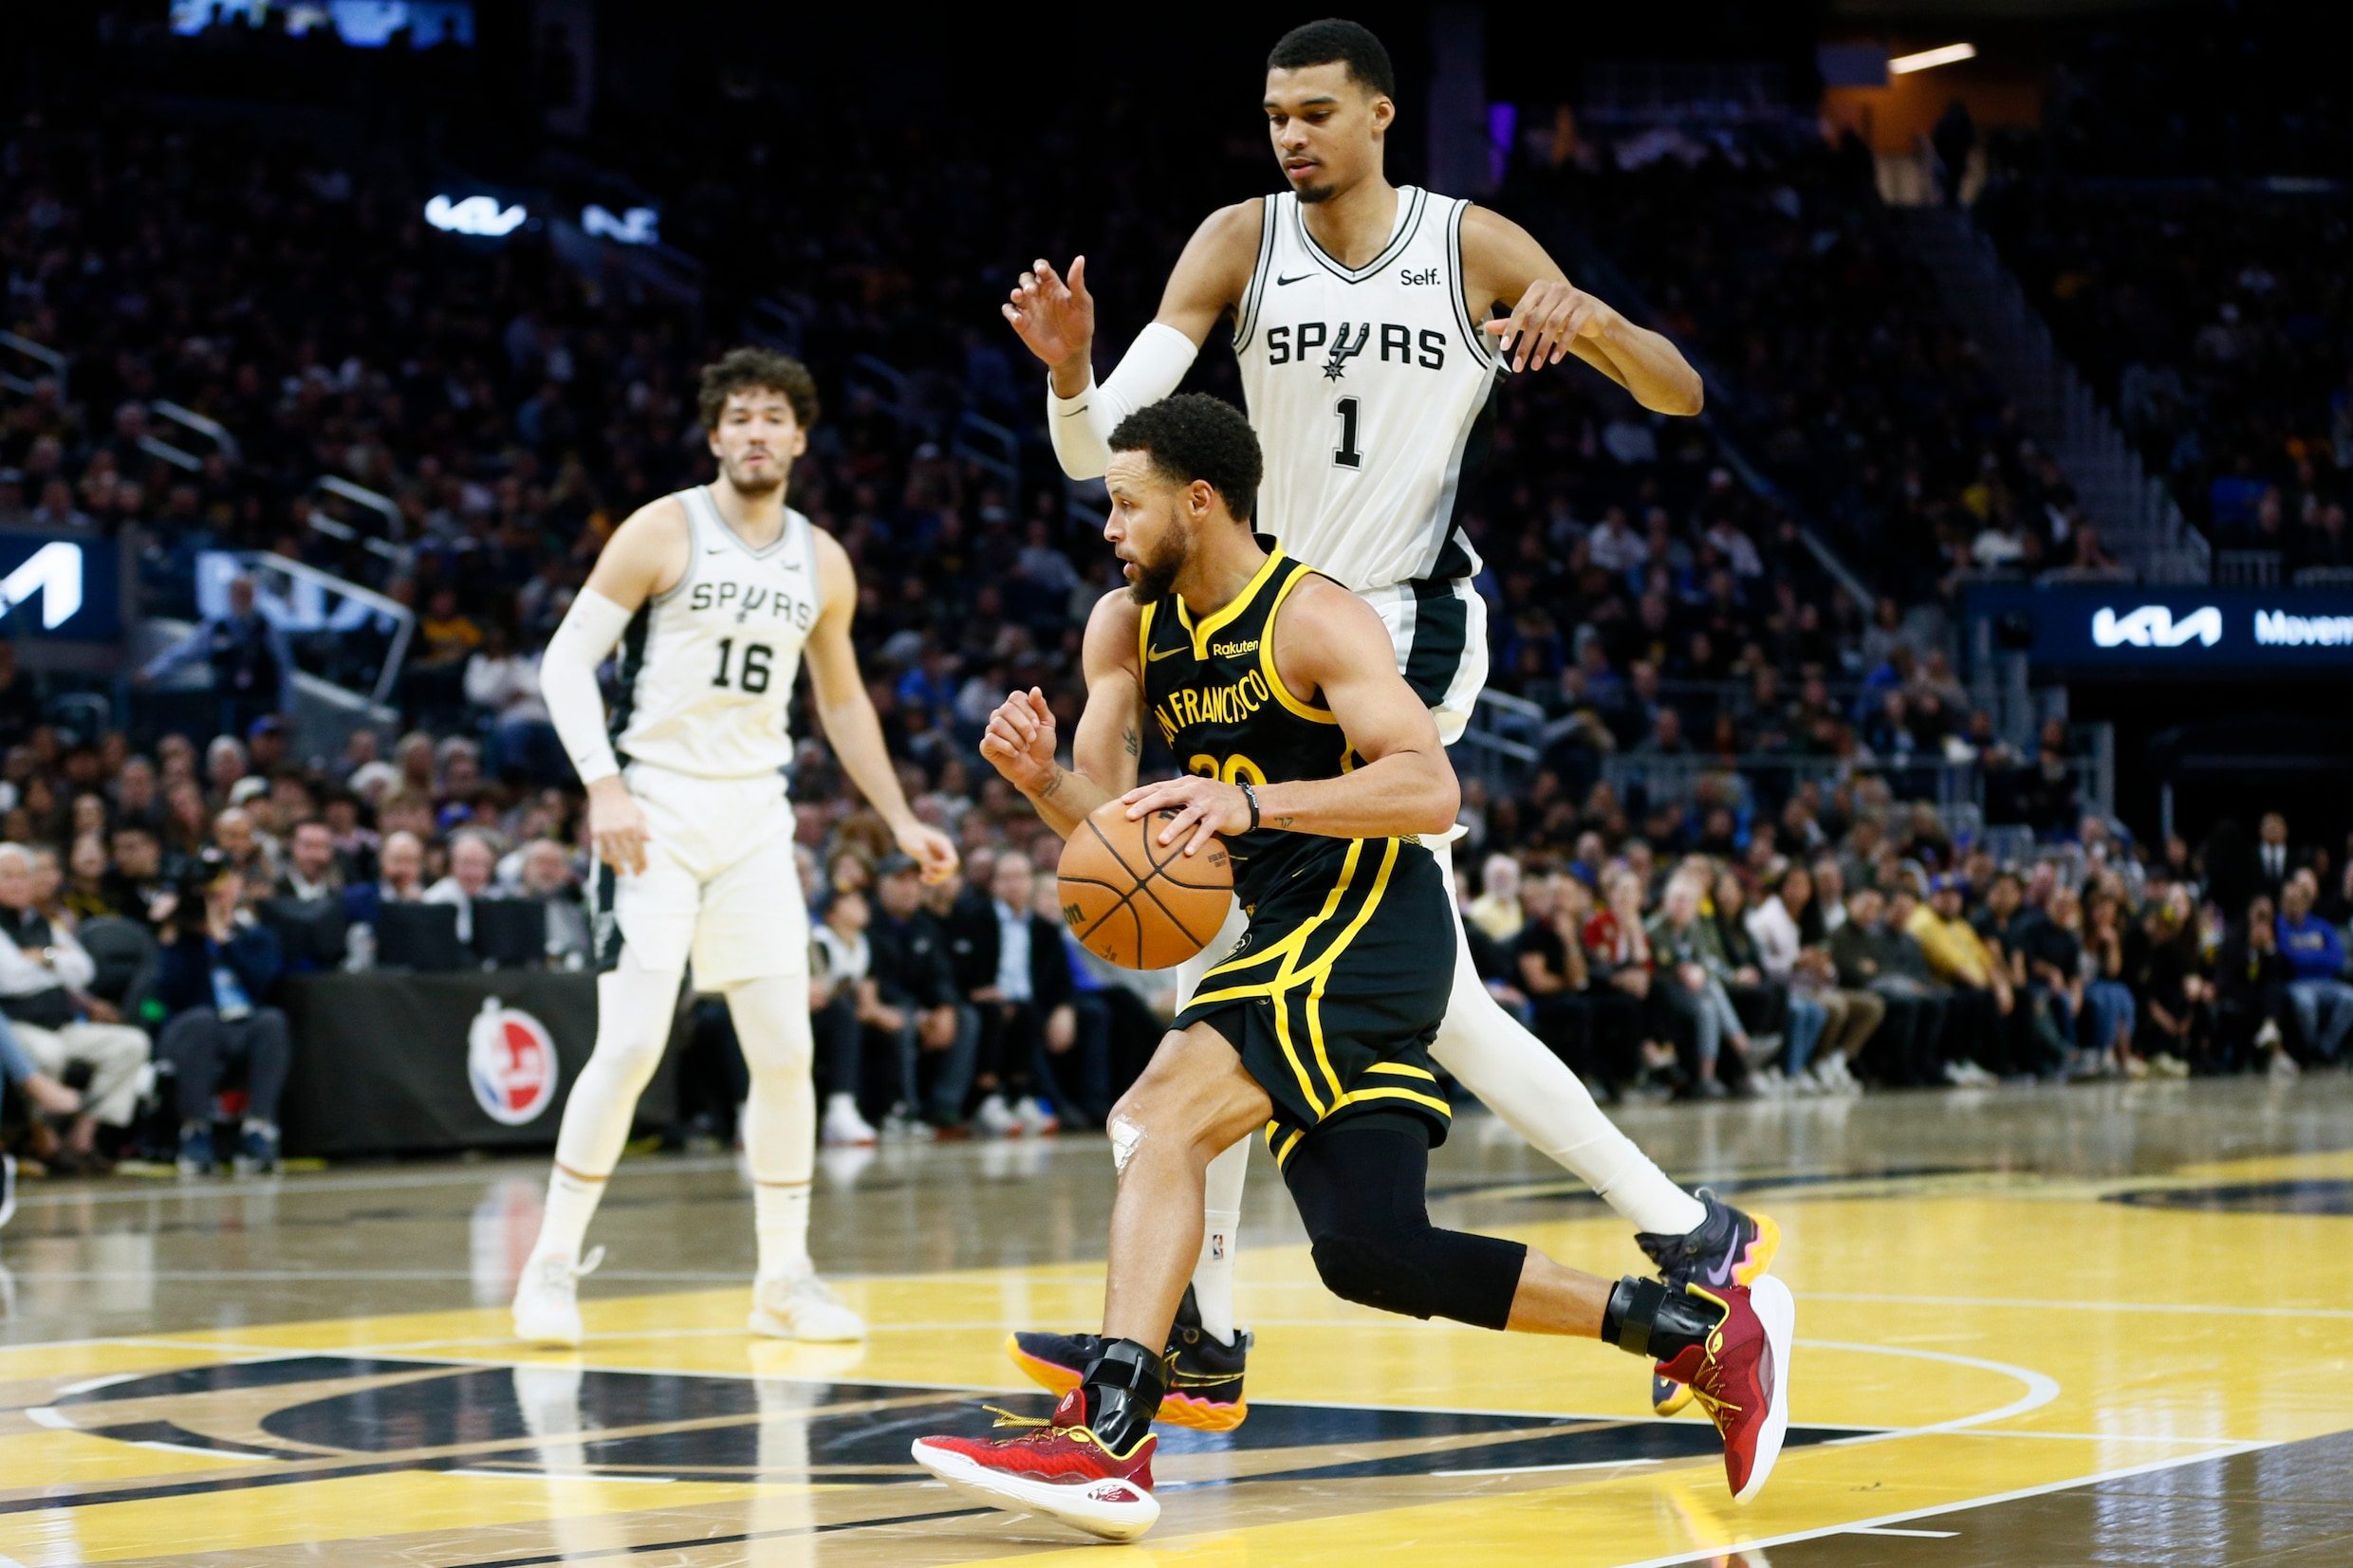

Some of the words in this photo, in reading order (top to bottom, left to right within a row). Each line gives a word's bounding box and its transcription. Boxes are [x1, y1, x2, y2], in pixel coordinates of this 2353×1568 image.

[1400, 268, 1441, 286] Self.
[1267, 322, 1447, 382] SPURS
[1332, 395, 1363, 471] 1
[690, 581, 812, 632] SPURS
[2092, 605, 2222, 648] KIA
[712, 637, 773, 694] 16
[1213, 639, 1259, 658] Rakuten
[1168, 669, 1269, 728] FRANCISCO
